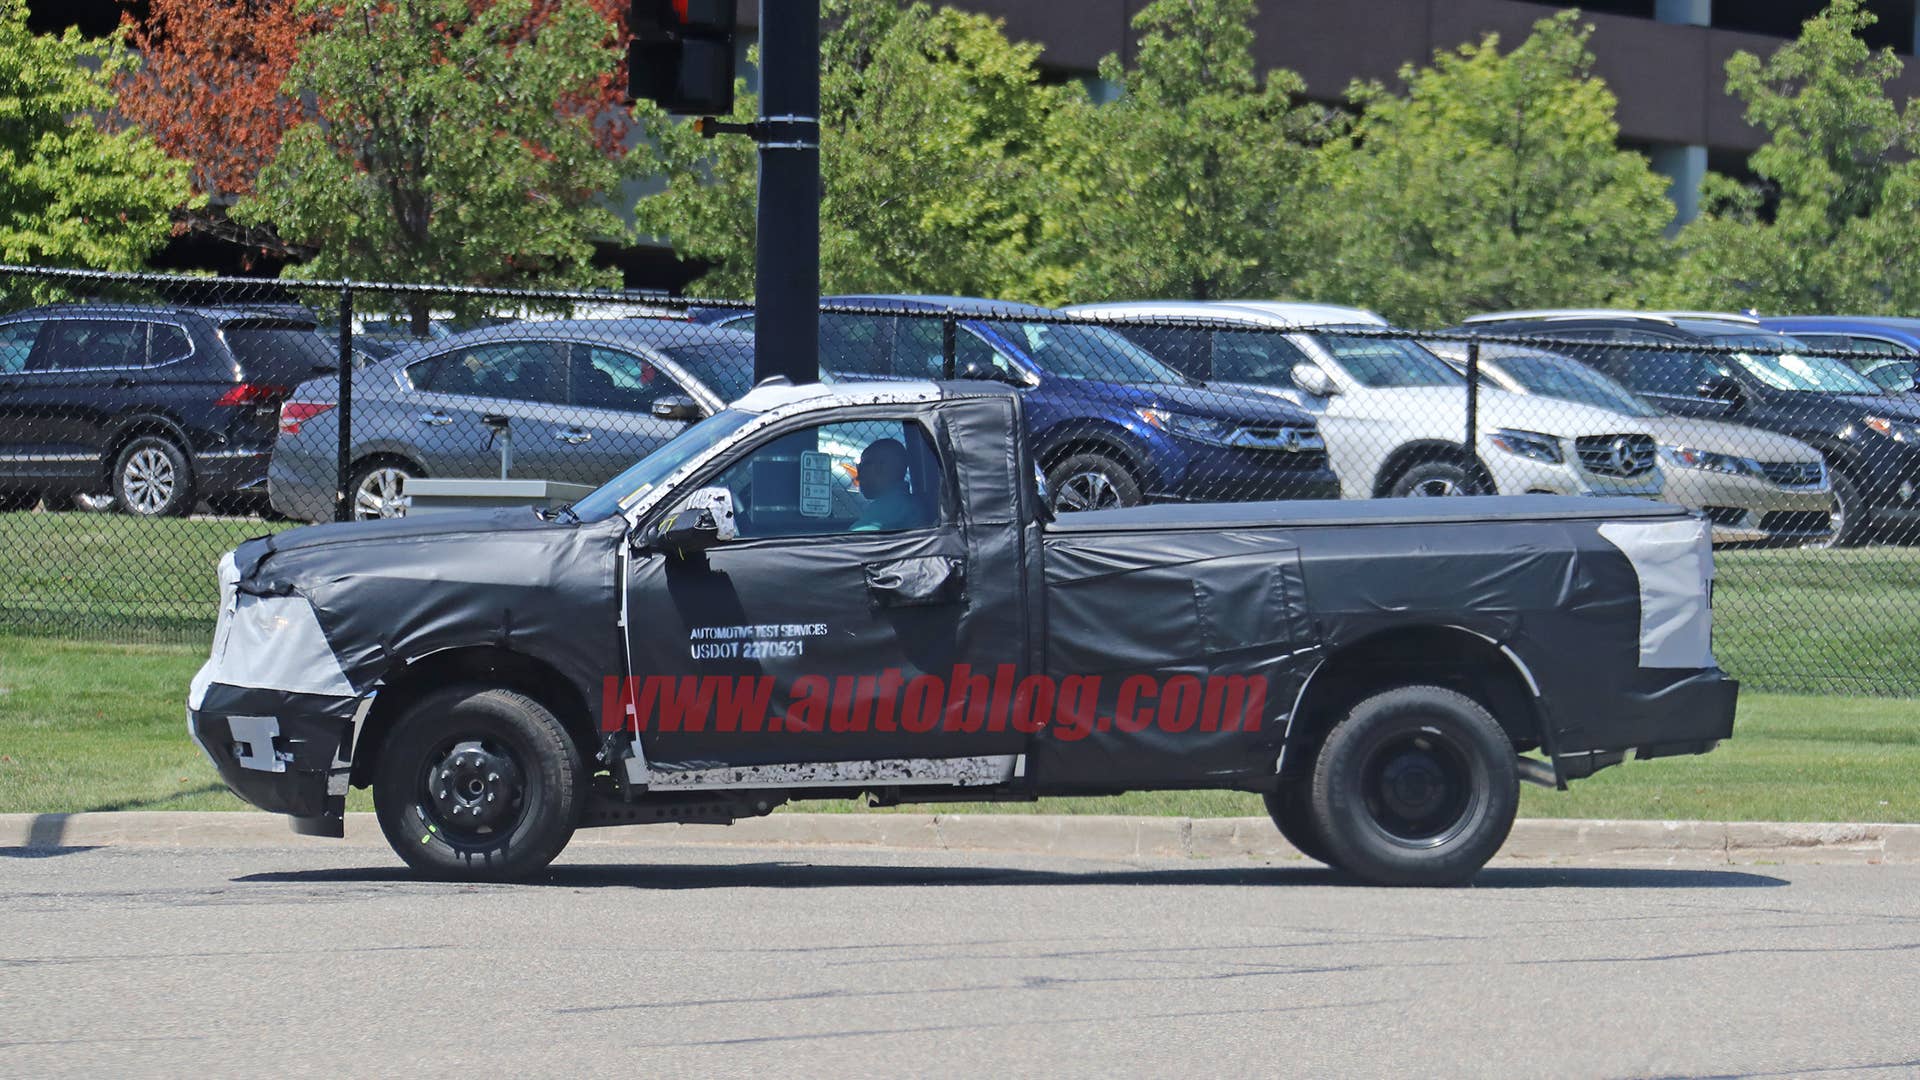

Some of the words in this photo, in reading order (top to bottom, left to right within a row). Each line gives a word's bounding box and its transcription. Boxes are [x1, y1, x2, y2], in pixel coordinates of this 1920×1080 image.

[691, 627, 753, 639] AUTOMOTIVE
[754, 625, 779, 638] TEST
[781, 624, 828, 637] SERVICES
[691, 641, 738, 659] USDOT
[743, 640, 804, 658] 2270521
